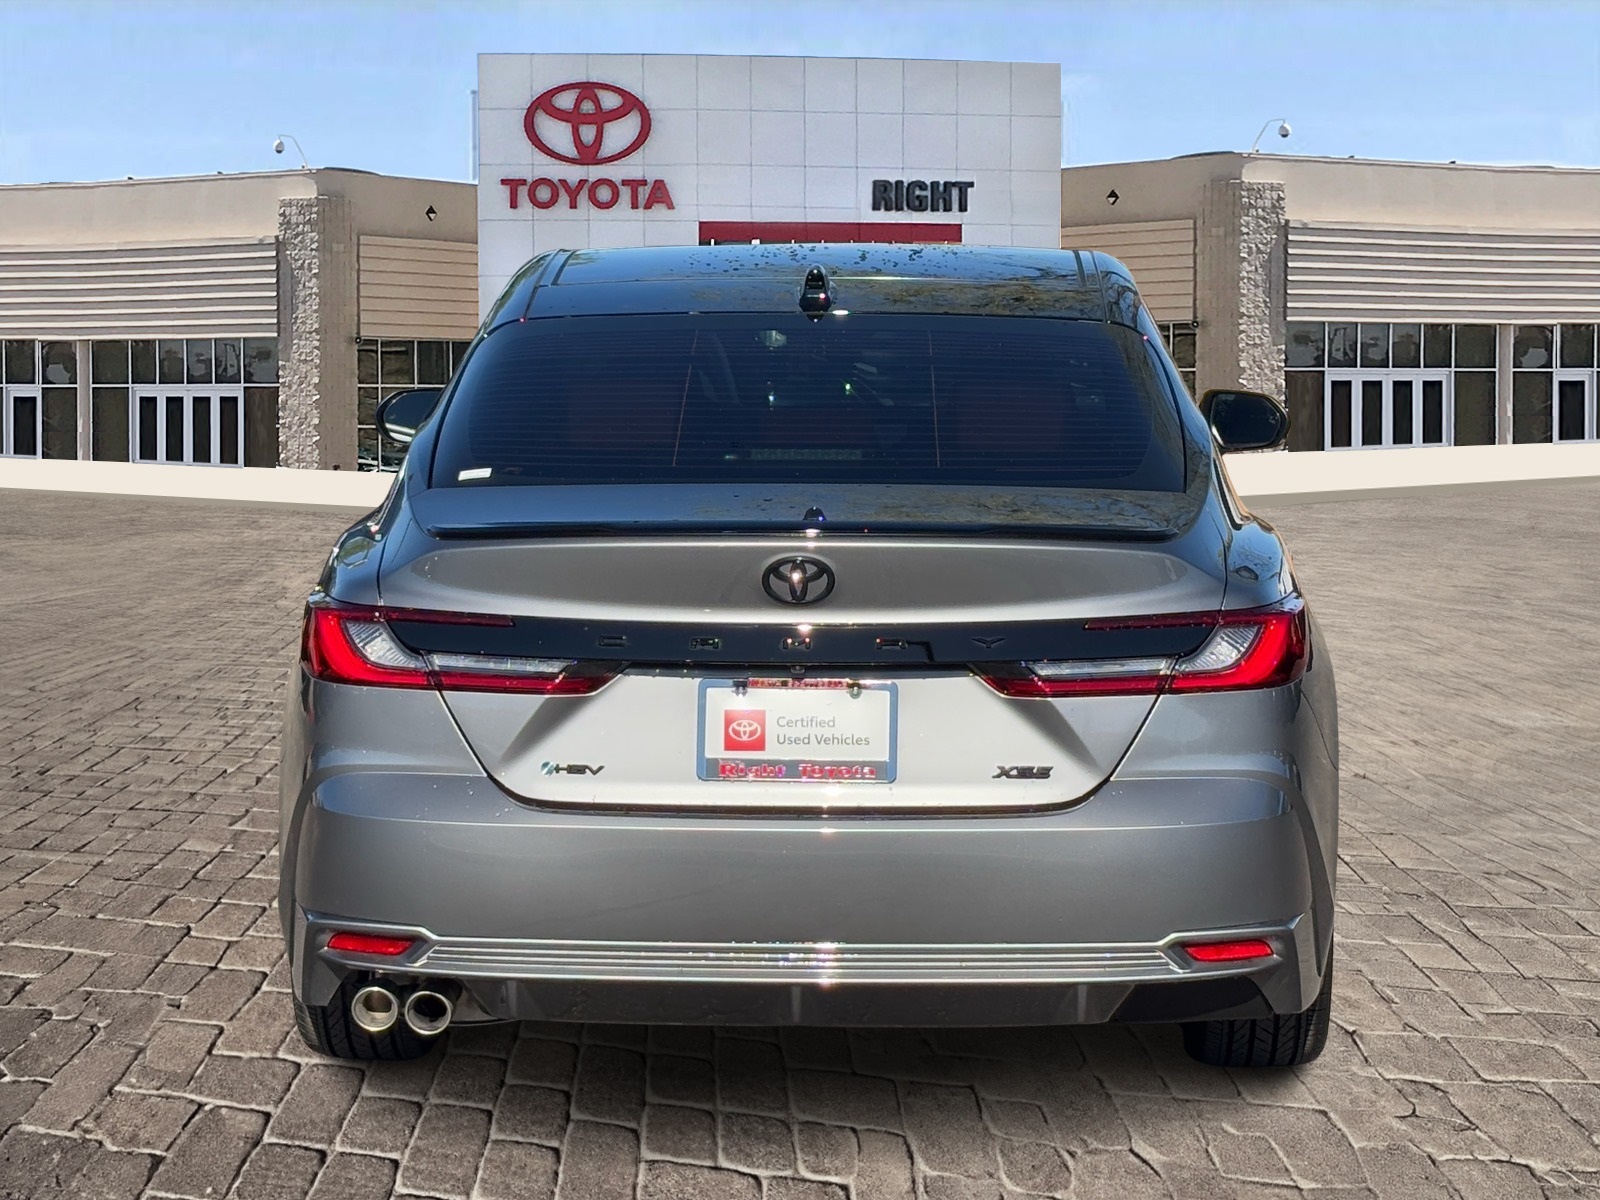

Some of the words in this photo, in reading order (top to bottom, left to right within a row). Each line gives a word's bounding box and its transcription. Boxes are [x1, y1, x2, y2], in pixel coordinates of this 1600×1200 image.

[501, 178, 675, 210] TOYOTA
[872, 180, 976, 213] RIGHT
[776, 716, 836, 728] Certified
[776, 733, 811, 746] Used
[814, 732, 871, 746] Vehicles
[718, 762, 786, 779] Right
[798, 763, 876, 779] Toyota
